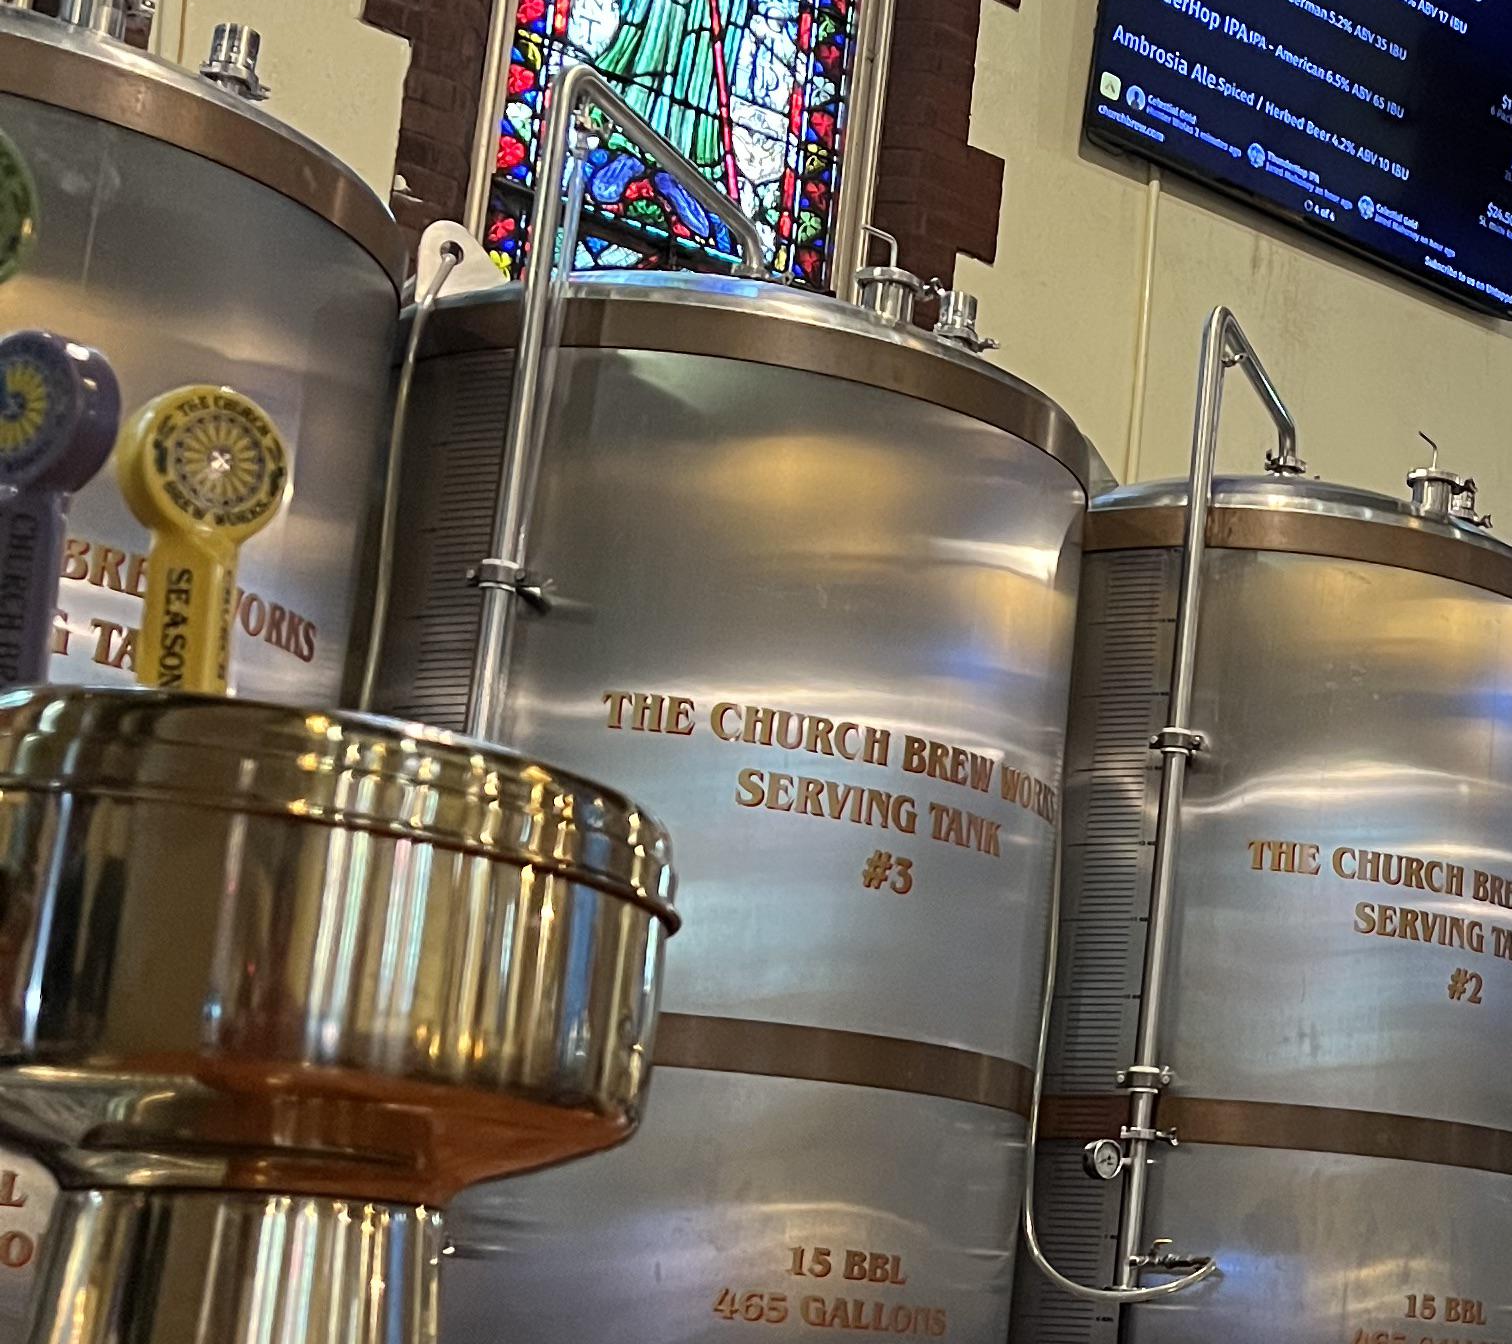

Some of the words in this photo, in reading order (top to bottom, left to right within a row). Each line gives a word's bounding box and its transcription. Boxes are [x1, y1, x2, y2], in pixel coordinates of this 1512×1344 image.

[1327, 10, 1353, 34] 5.2%
[1353, 24, 1376, 44] ABV
[1374, 35, 1388, 51] 35
[1389, 42, 1407, 61] IBU
[1449, 15, 1468, 34] IBU
[1223, 15, 1249, 43] IPA
[1248, 30, 1268, 50] IPA
[1274, 44, 1325, 80] American
[1325, 70, 1350, 92] 6.5%
[1351, 83, 1373, 102] ABV
[1386, 100, 1405, 119] IBU
[1112, 24, 1188, 76] Ambrosia
[1190, 63, 1217, 89] Ale
[1216, 77, 1255, 106] Spiced
[1265, 100, 1306, 130] Herbed
[1305, 120, 1331, 142] Beer
[1356, 146, 1378, 166] ABV
[1378, 156, 1390, 172] 10
[1391, 162, 1410, 181] IBU
[65, 538, 149, 599] BRE
[158, 567, 193, 690] SEASON
[603, 690, 696, 735] THE
[710, 702, 891, 766] CHURCH
[903, 734, 995, 793] BREW
[735, 768, 918, 834] SERVING
[929, 801, 1002, 857] TANK
[862, 849, 913, 895] #3
[1248, 840, 1322, 875] THE
[1332, 846, 1464, 897] CHURCH
[1353, 901, 1485, 954] SERVING
[1447, 967, 1484, 1005] #2
[786, 1246, 832, 1278] 15
[843, 1249, 908, 1285] BBL
[712, 1287, 788, 1325] 465
[800, 1294, 948, 1337] GALLONS
[1405, 1293, 1437, 1320] 15
[1445, 1296, 1488, 1325] BBL
